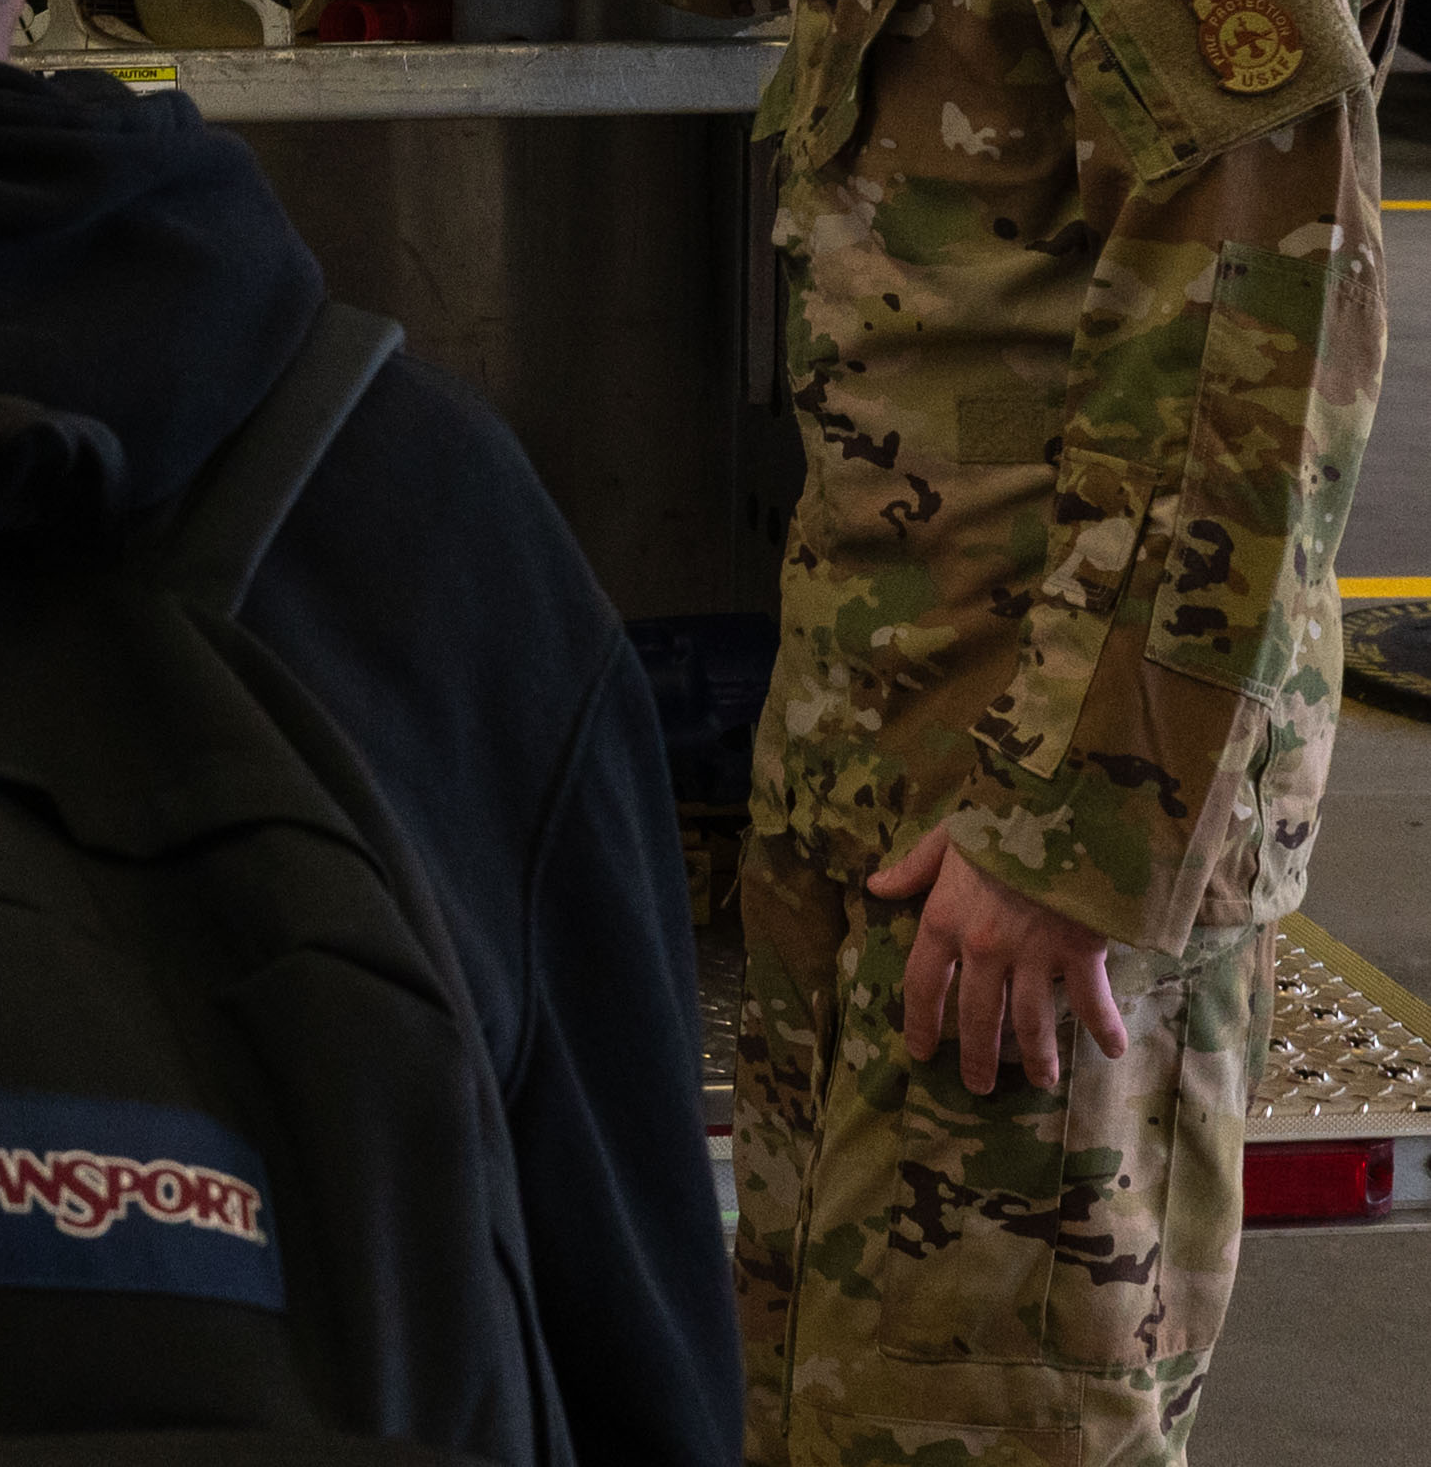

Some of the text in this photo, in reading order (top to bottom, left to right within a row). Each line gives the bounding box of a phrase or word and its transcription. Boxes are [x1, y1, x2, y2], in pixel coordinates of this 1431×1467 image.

[1204, 32, 1226, 66] FIRE
[112, 70, 157, 78] CAUTION
[1242, 56, 1289, 87] USAF
